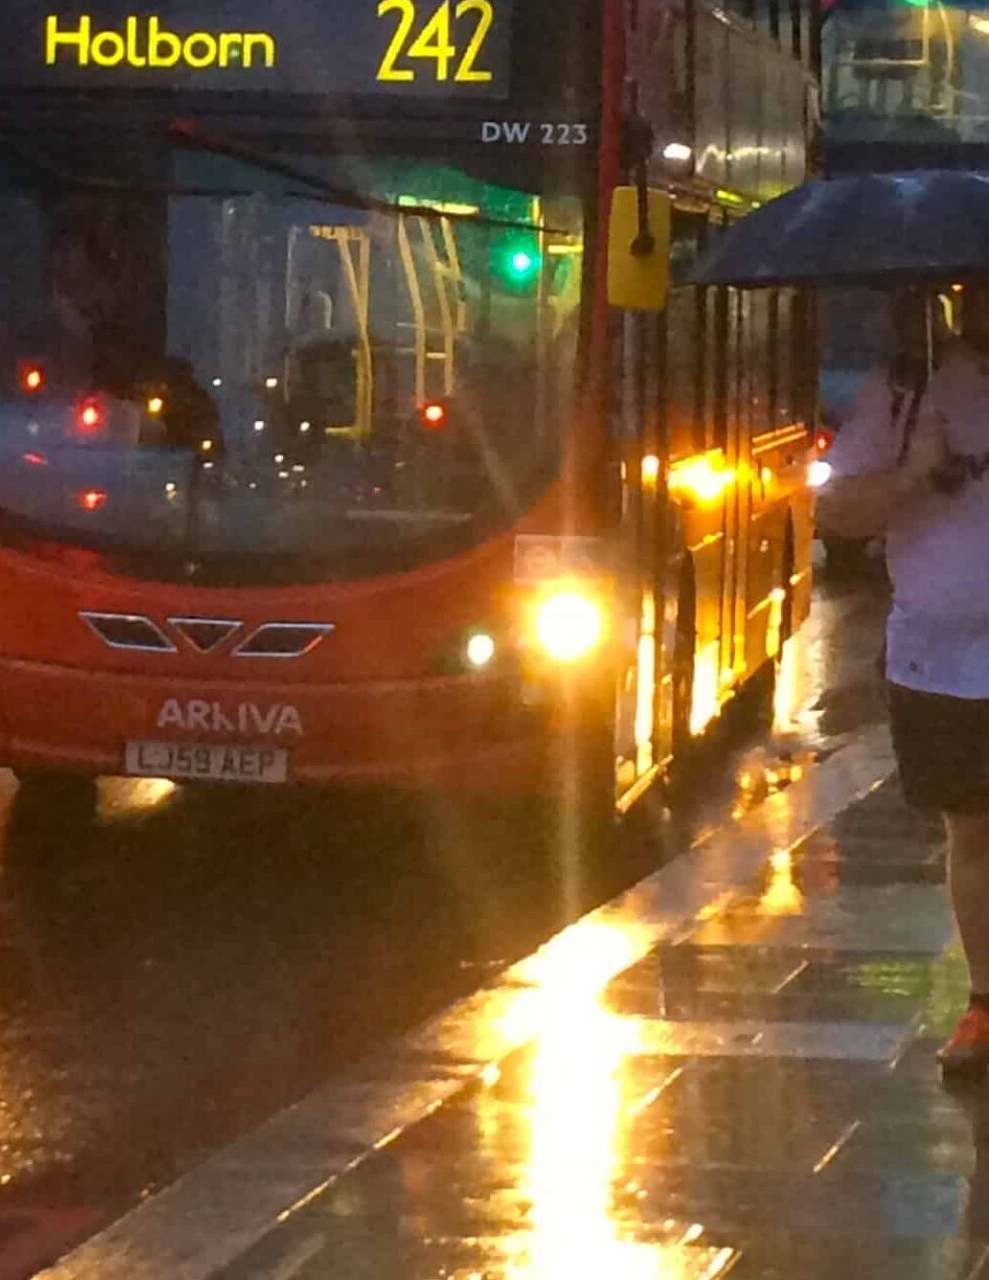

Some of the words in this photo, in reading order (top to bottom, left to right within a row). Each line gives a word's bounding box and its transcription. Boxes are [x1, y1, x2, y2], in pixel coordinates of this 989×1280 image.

[45, 14, 275, 68] Holborn
[481, 121, 531, 143] DW
[539, 123, 587, 145] 223
[137, 745, 210, 774] LJ59
